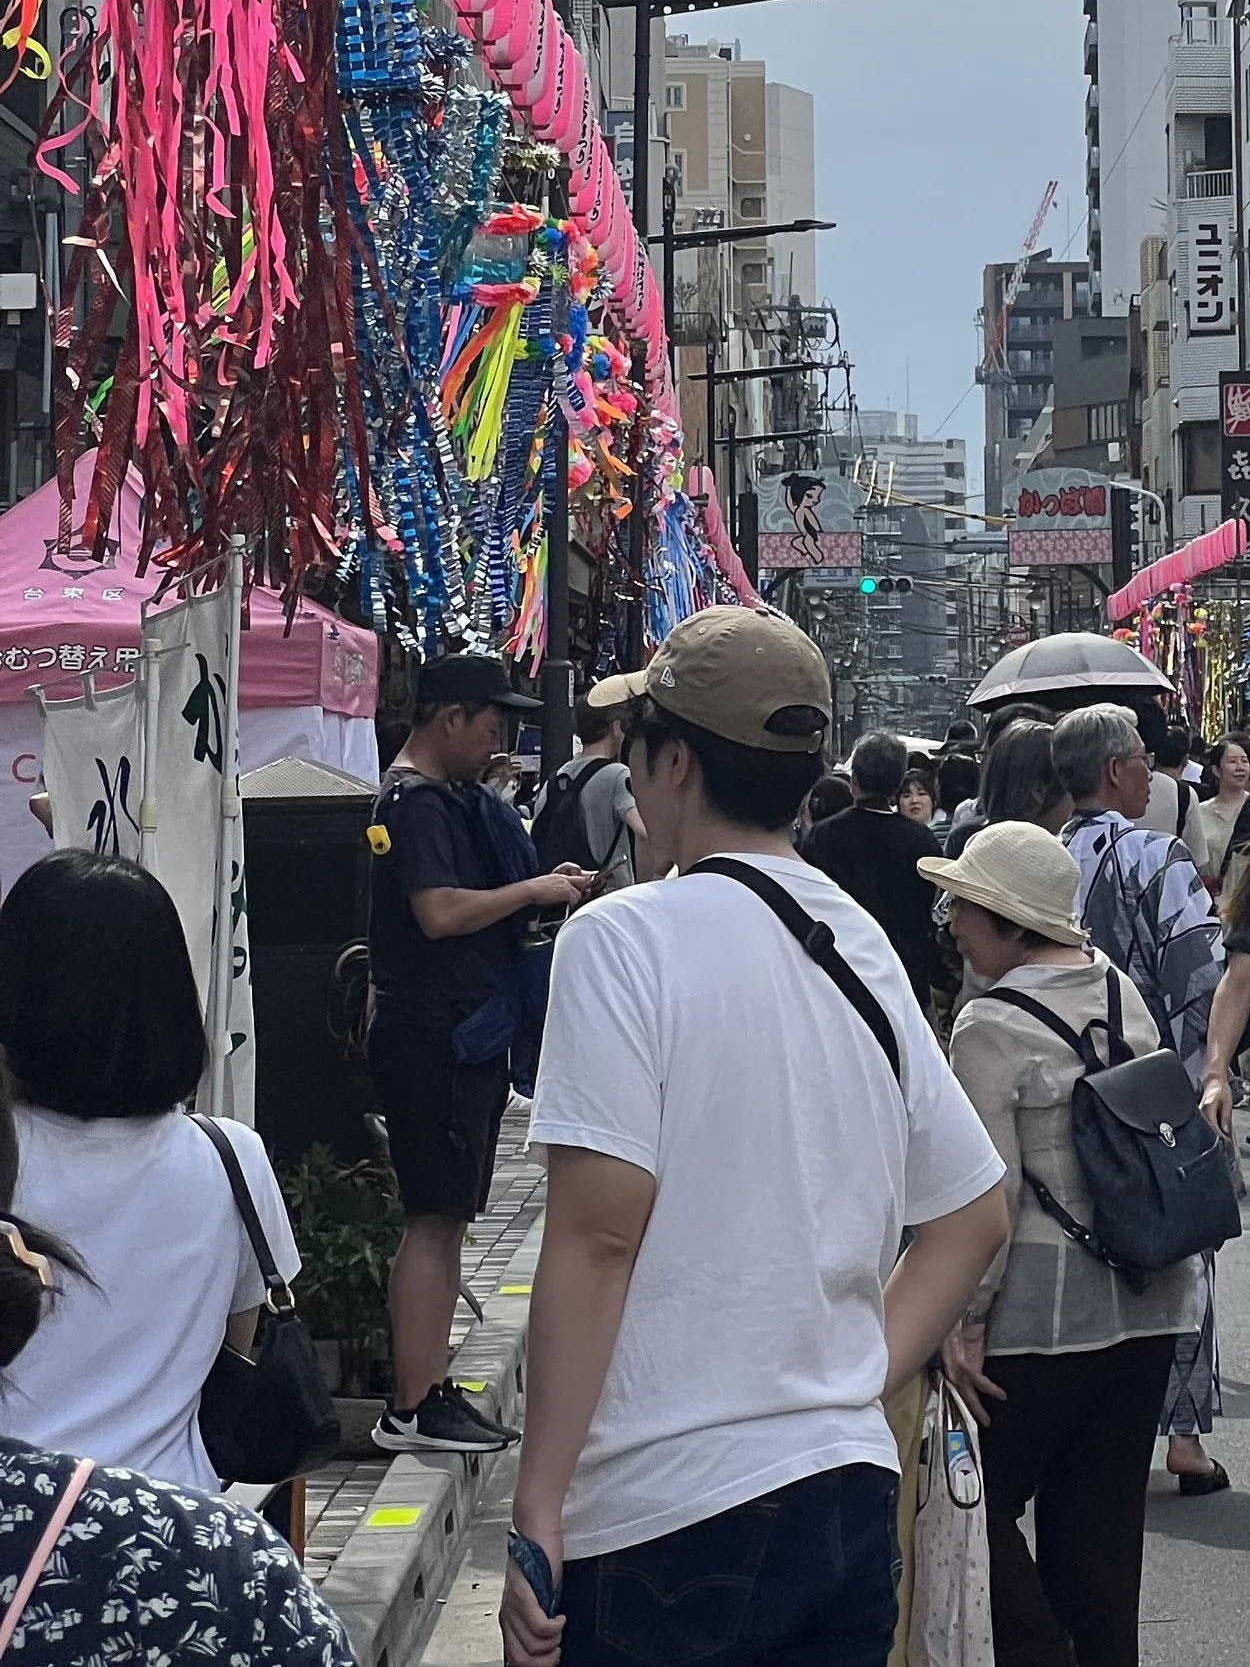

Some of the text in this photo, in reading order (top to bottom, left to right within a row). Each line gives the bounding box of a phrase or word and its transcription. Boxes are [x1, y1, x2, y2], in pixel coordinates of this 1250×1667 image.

[1196, 224, 1223, 323] ユニオン
[23, 587, 126, 602] 台東区
[0, 643, 139, 673] むつ替え用
